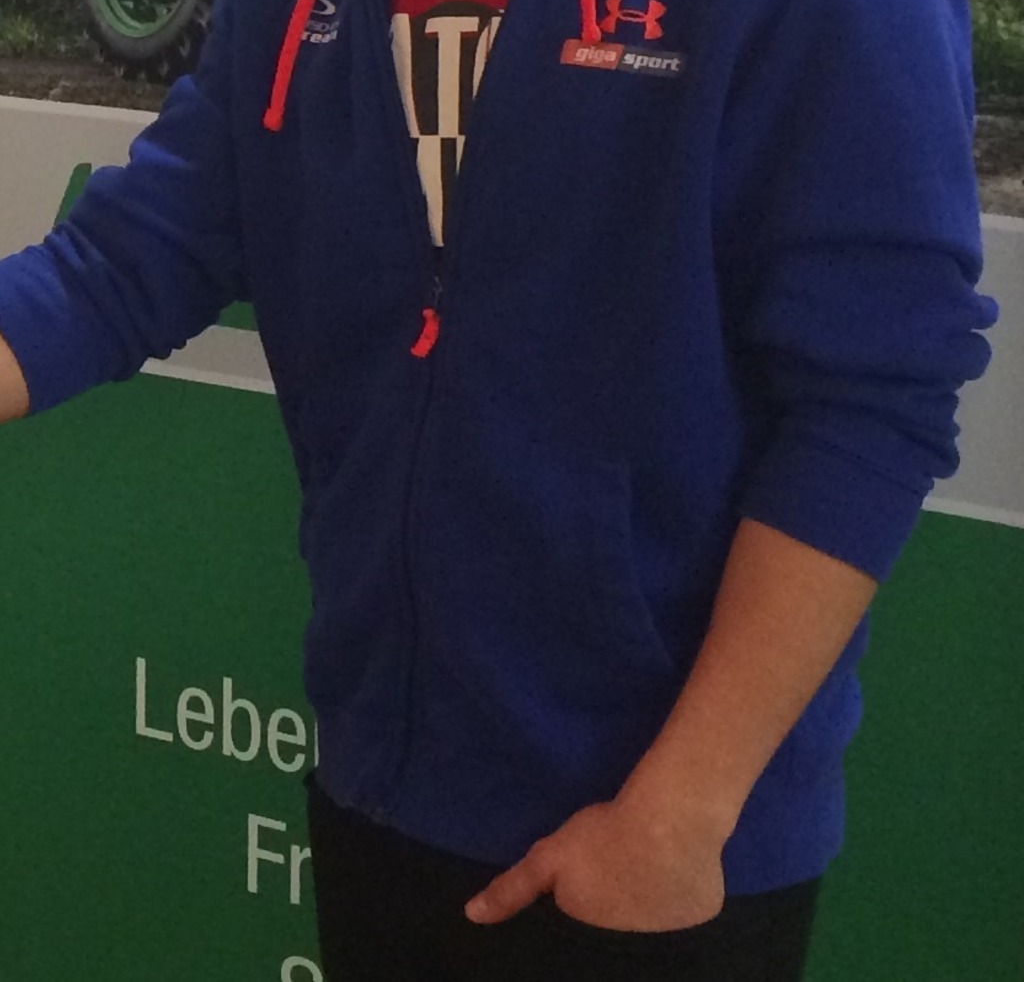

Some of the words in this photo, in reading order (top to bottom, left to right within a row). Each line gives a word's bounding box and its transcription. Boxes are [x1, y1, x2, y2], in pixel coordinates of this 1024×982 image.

[575, 46, 617, 64] giga
[622, 53, 681, 71] sport
[135, 657, 319, 773] Lebe
[247, 813, 312, 905] Fr
